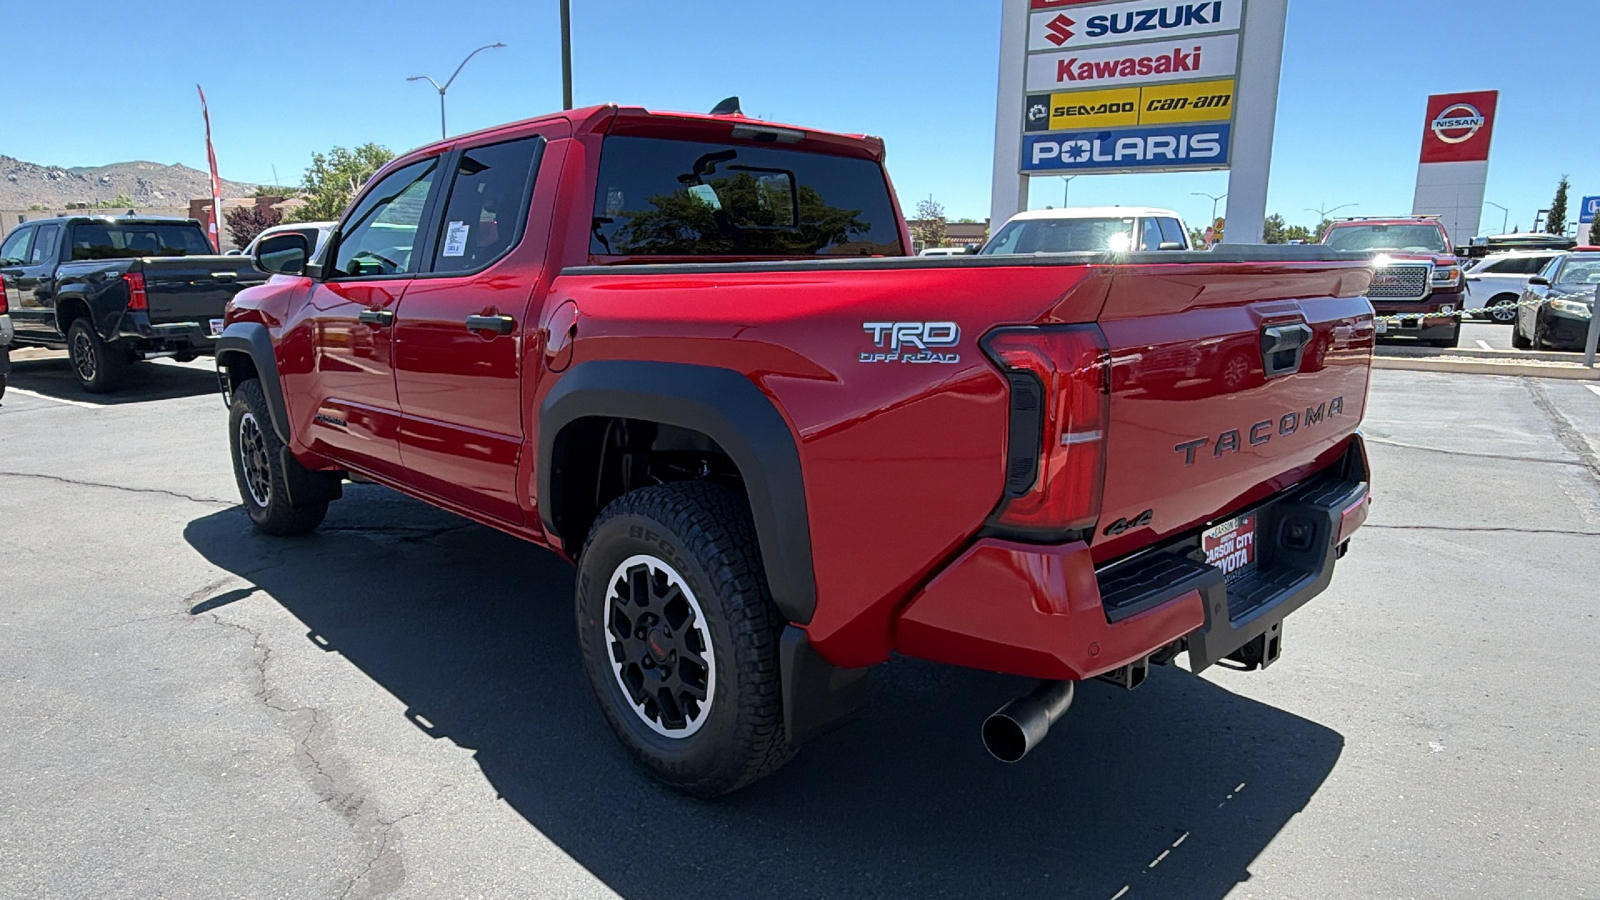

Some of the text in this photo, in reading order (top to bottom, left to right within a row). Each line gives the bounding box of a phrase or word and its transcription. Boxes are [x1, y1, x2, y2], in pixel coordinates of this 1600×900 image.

[1085, 1, 1222, 37] SUZUKI
[1056, 46, 1202, 82] Kawasaki
[1436, 119, 1479, 127] NISSAN
[1031, 133, 1220, 164] POLARIS
[863, 322, 960, 353] TRD
[859, 352, 960, 363] OFF ROAD
[1174, 396, 1344, 466] TACOMA
[1236, 531, 1254, 549] CITY
[1210, 548, 1248, 575] YOTA
